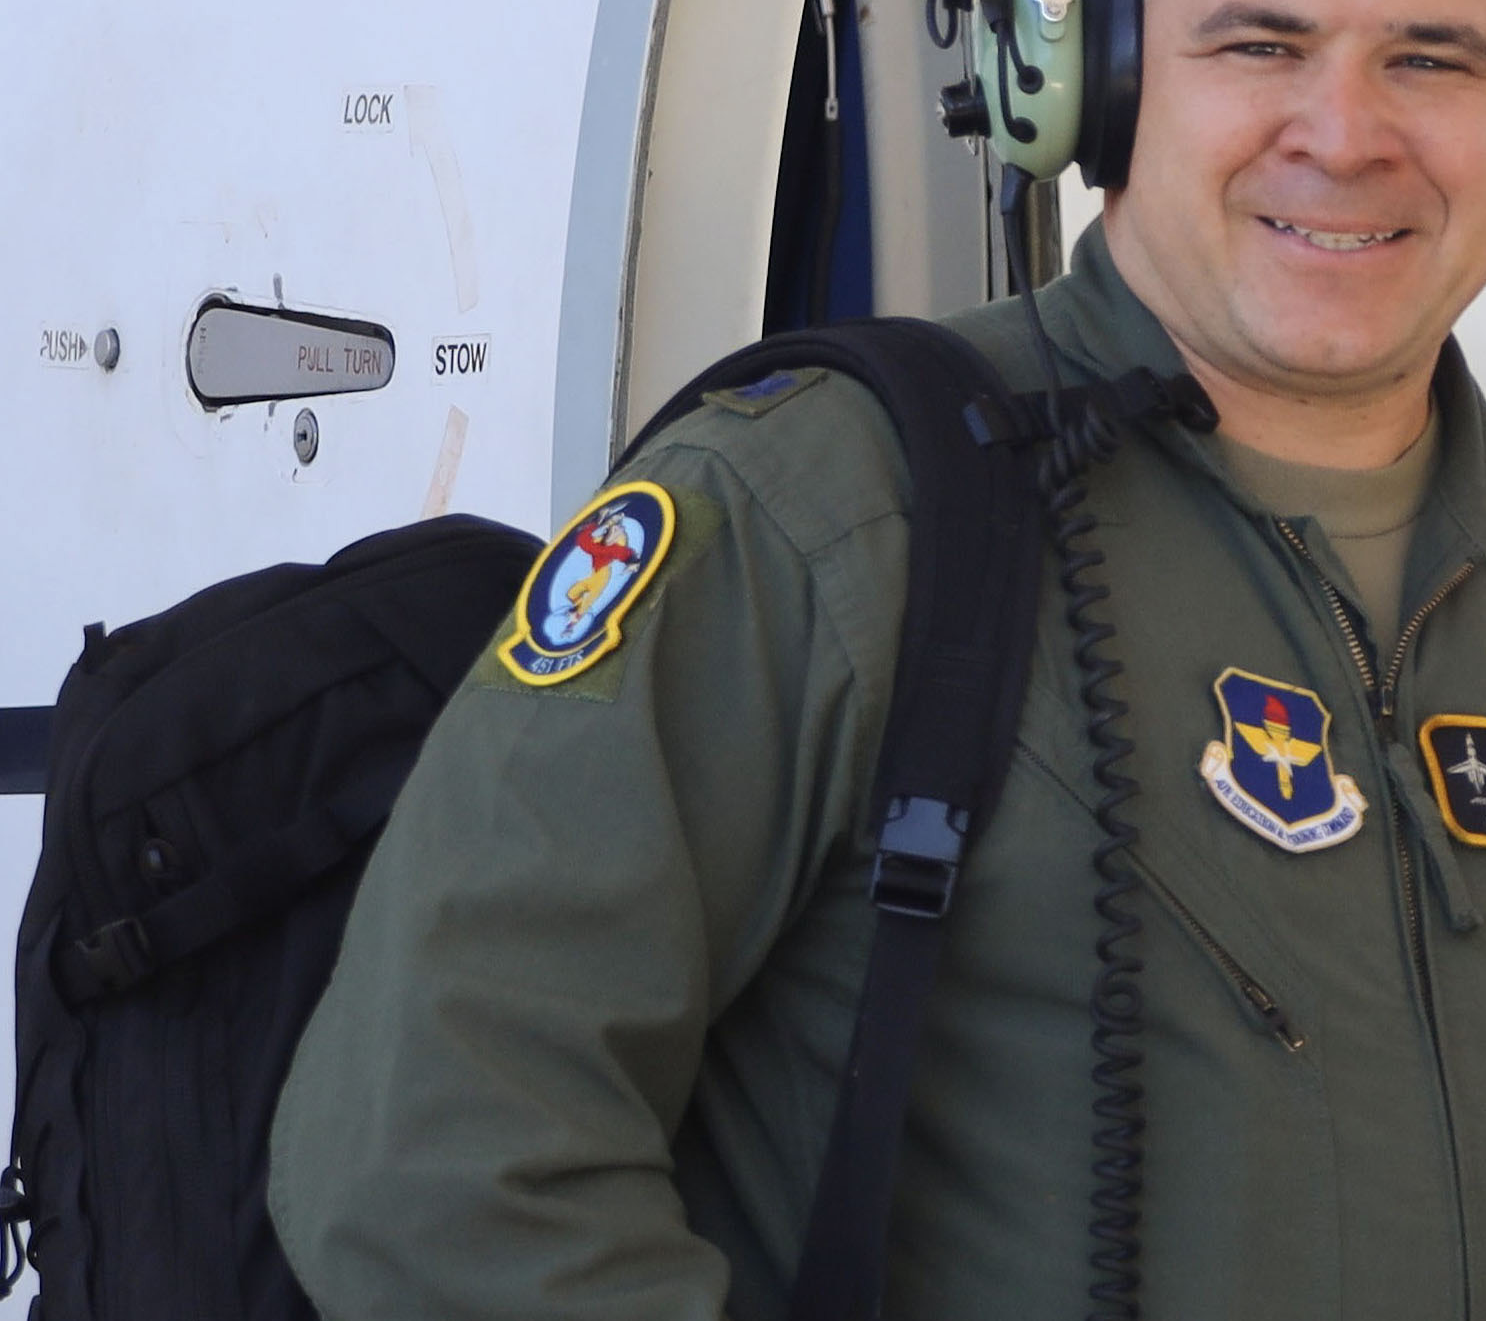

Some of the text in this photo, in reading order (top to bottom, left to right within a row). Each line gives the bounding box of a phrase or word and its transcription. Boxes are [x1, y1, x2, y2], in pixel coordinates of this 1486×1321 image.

[343, 94, 394, 125] LOCK
[40, 330, 80, 362] PUSH
[298, 345, 382, 375] PULL TURN
[435, 343, 487, 376] STOW
